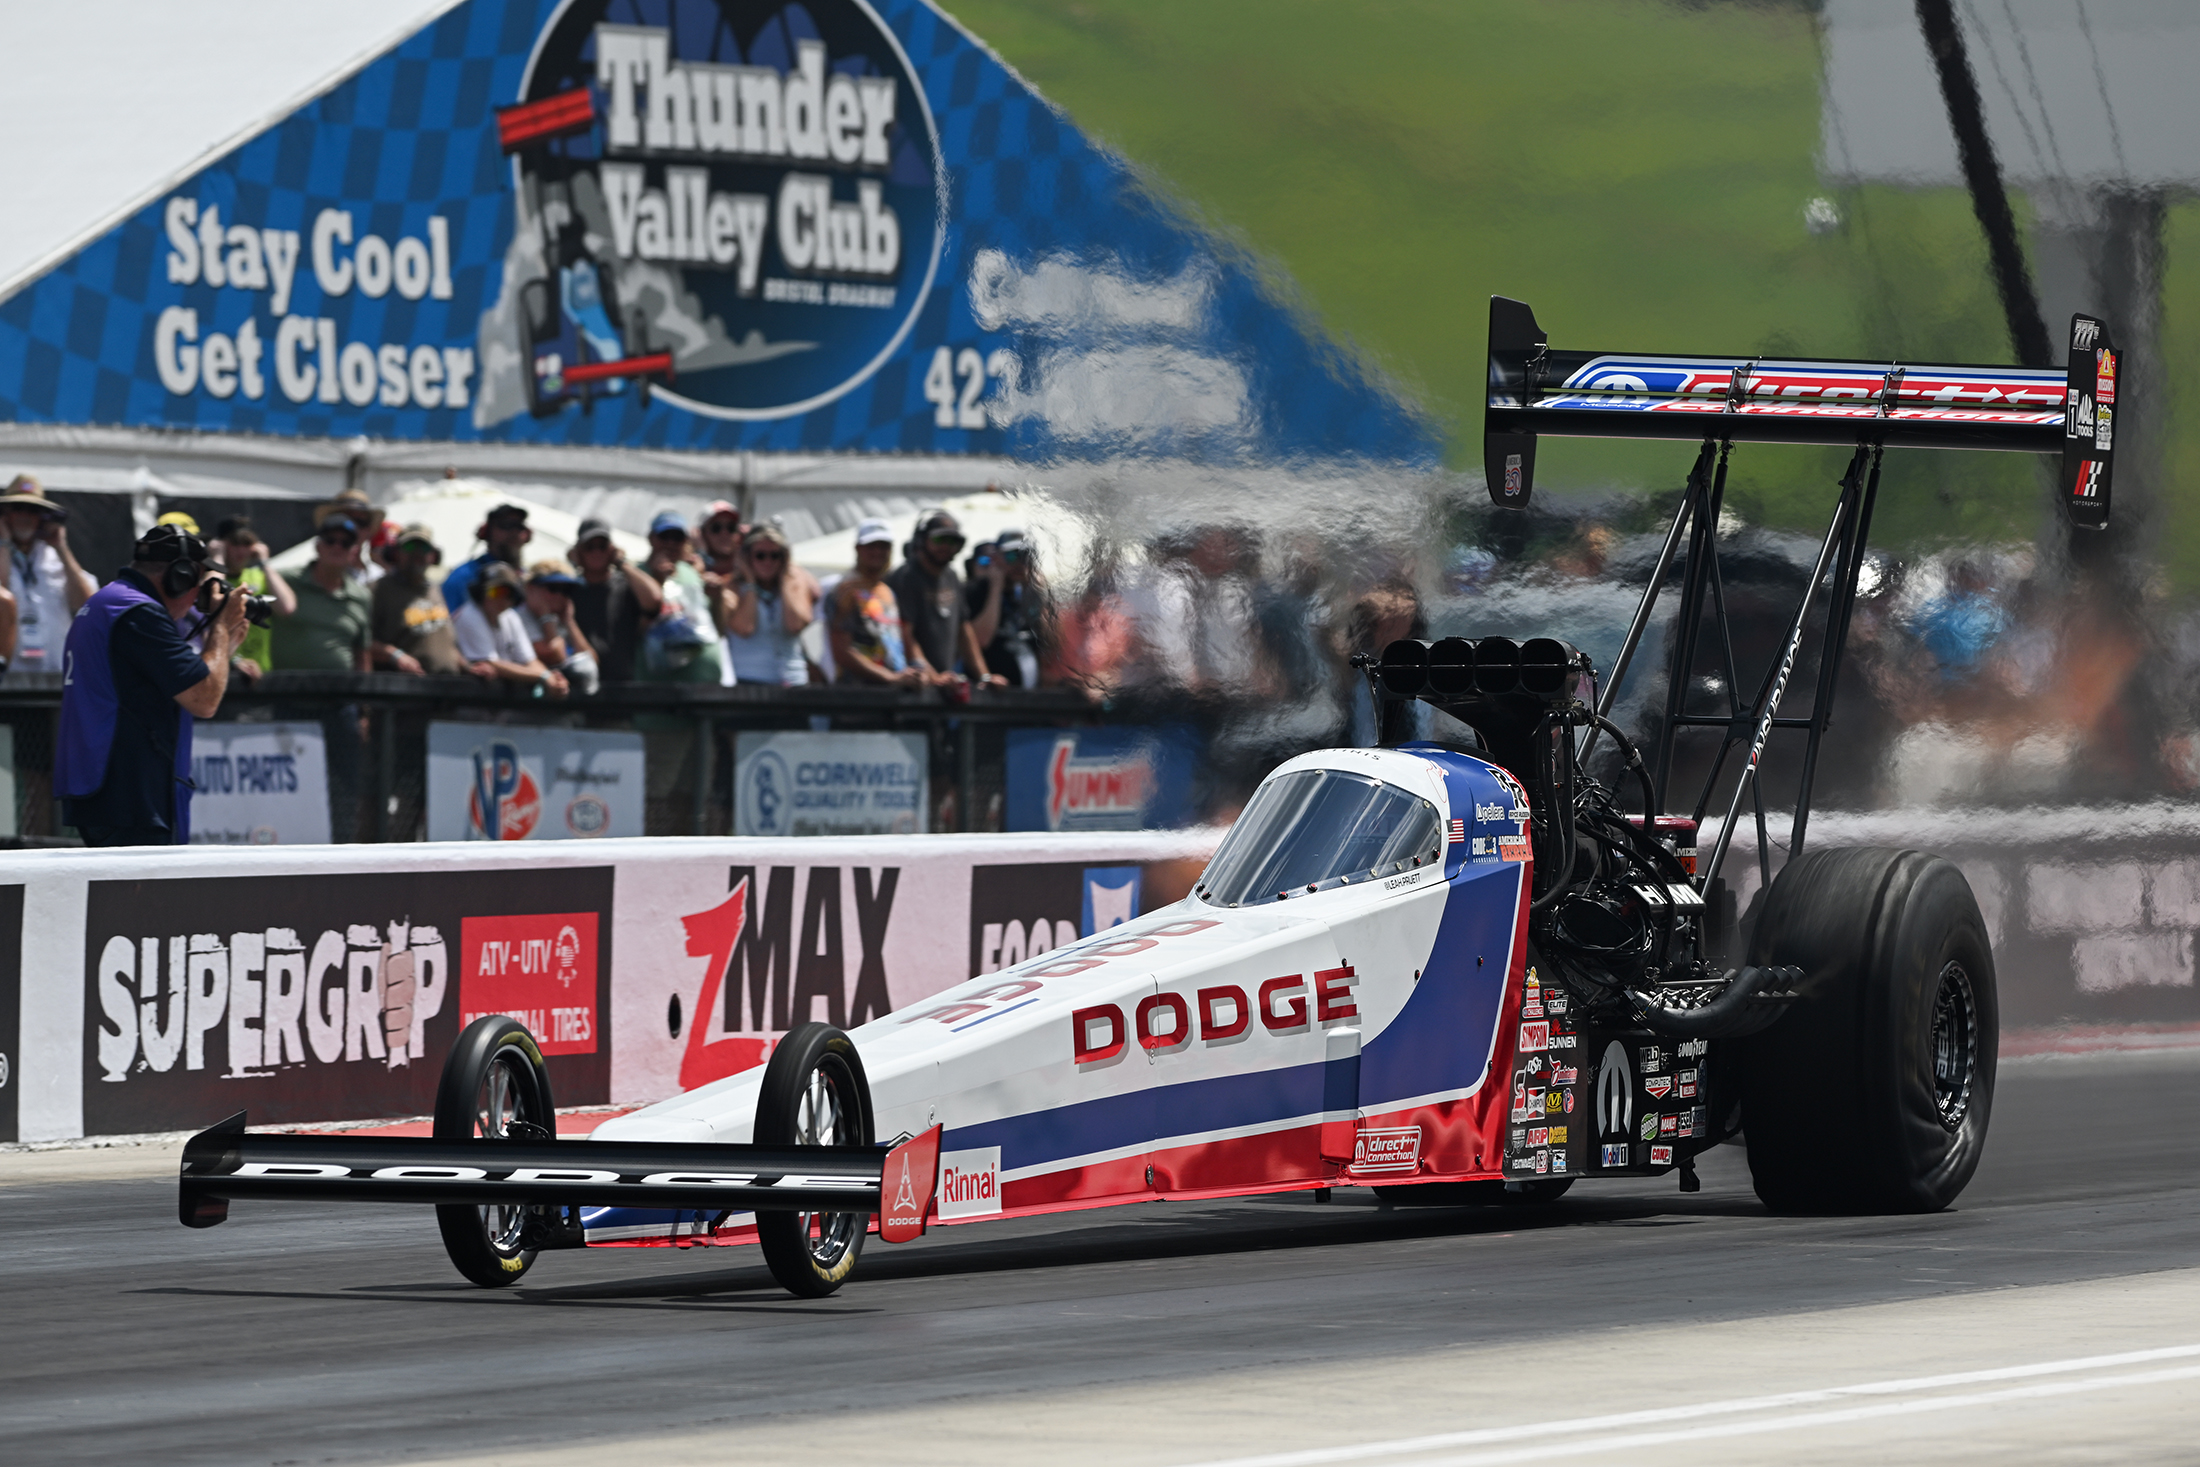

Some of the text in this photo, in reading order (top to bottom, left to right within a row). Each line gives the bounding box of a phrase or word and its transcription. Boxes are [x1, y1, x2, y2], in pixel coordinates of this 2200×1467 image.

[596, 24, 896, 165] Thunder
[601, 163, 900, 296] Valley Club
[166, 197, 452, 315] Stay Cool
[155, 307, 474, 408] Get Closer
[2078, 425, 2094, 438] TOOLS
[236, 753, 298, 795] PARTS
[551, 1007, 592, 1043] TIRES
[1071, 965, 1361, 1068] DODGE
[1521, 1024, 1549, 1049] SIMPSON
[1549, 1036, 1577, 1049] SUNNEN
[1370, 1136, 1406, 1151] direct
[1527, 1128, 1548, 1145] ARP
[1368, 1150, 1413, 1162] connection
[1602, 1148, 1620, 1165] Mobil
[1651, 1148, 1669, 1161] COMP
[231, 1162, 882, 1189] DODGE
[944, 1162, 995, 1203] Rinnai
[888, 1217, 922, 1226] DODGE
